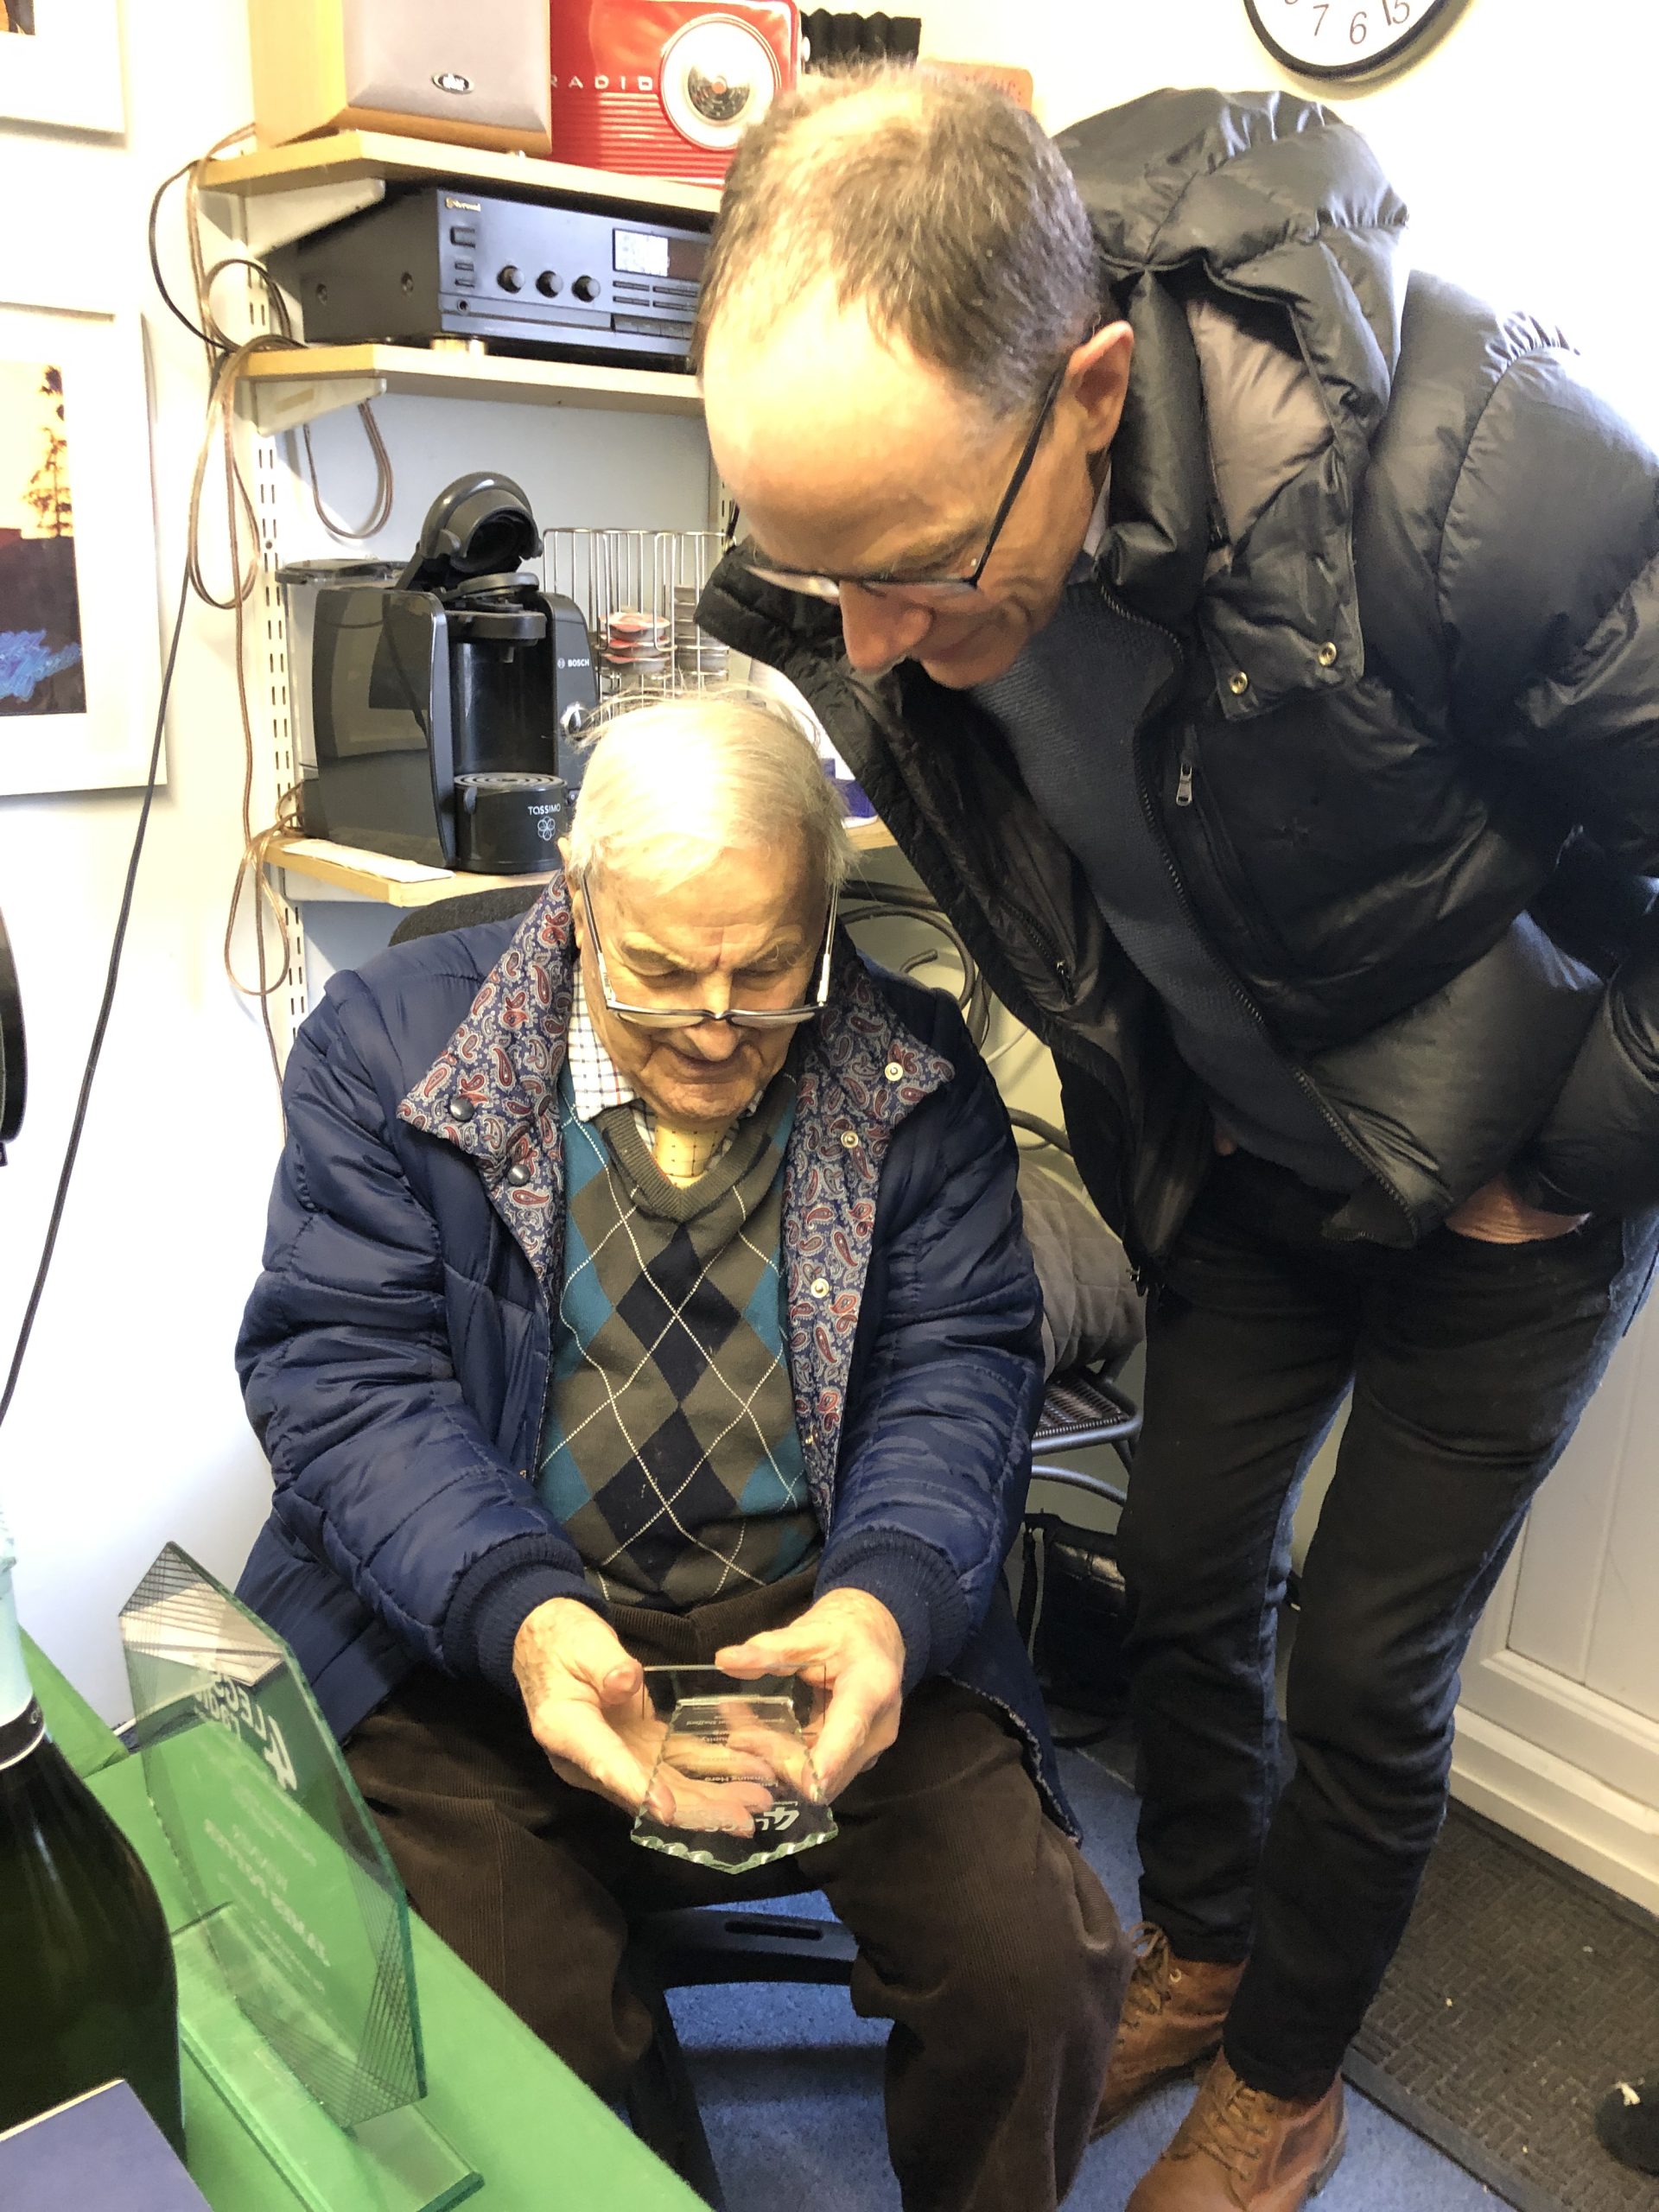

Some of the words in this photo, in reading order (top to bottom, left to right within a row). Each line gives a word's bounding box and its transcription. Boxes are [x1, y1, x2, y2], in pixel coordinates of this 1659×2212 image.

[1313, 3, 1329, 36] 7
[1349, 11, 1367, 44] 6
[567, 658, 590, 667] BOSCH
[527, 803, 562, 816] TASSIMO
